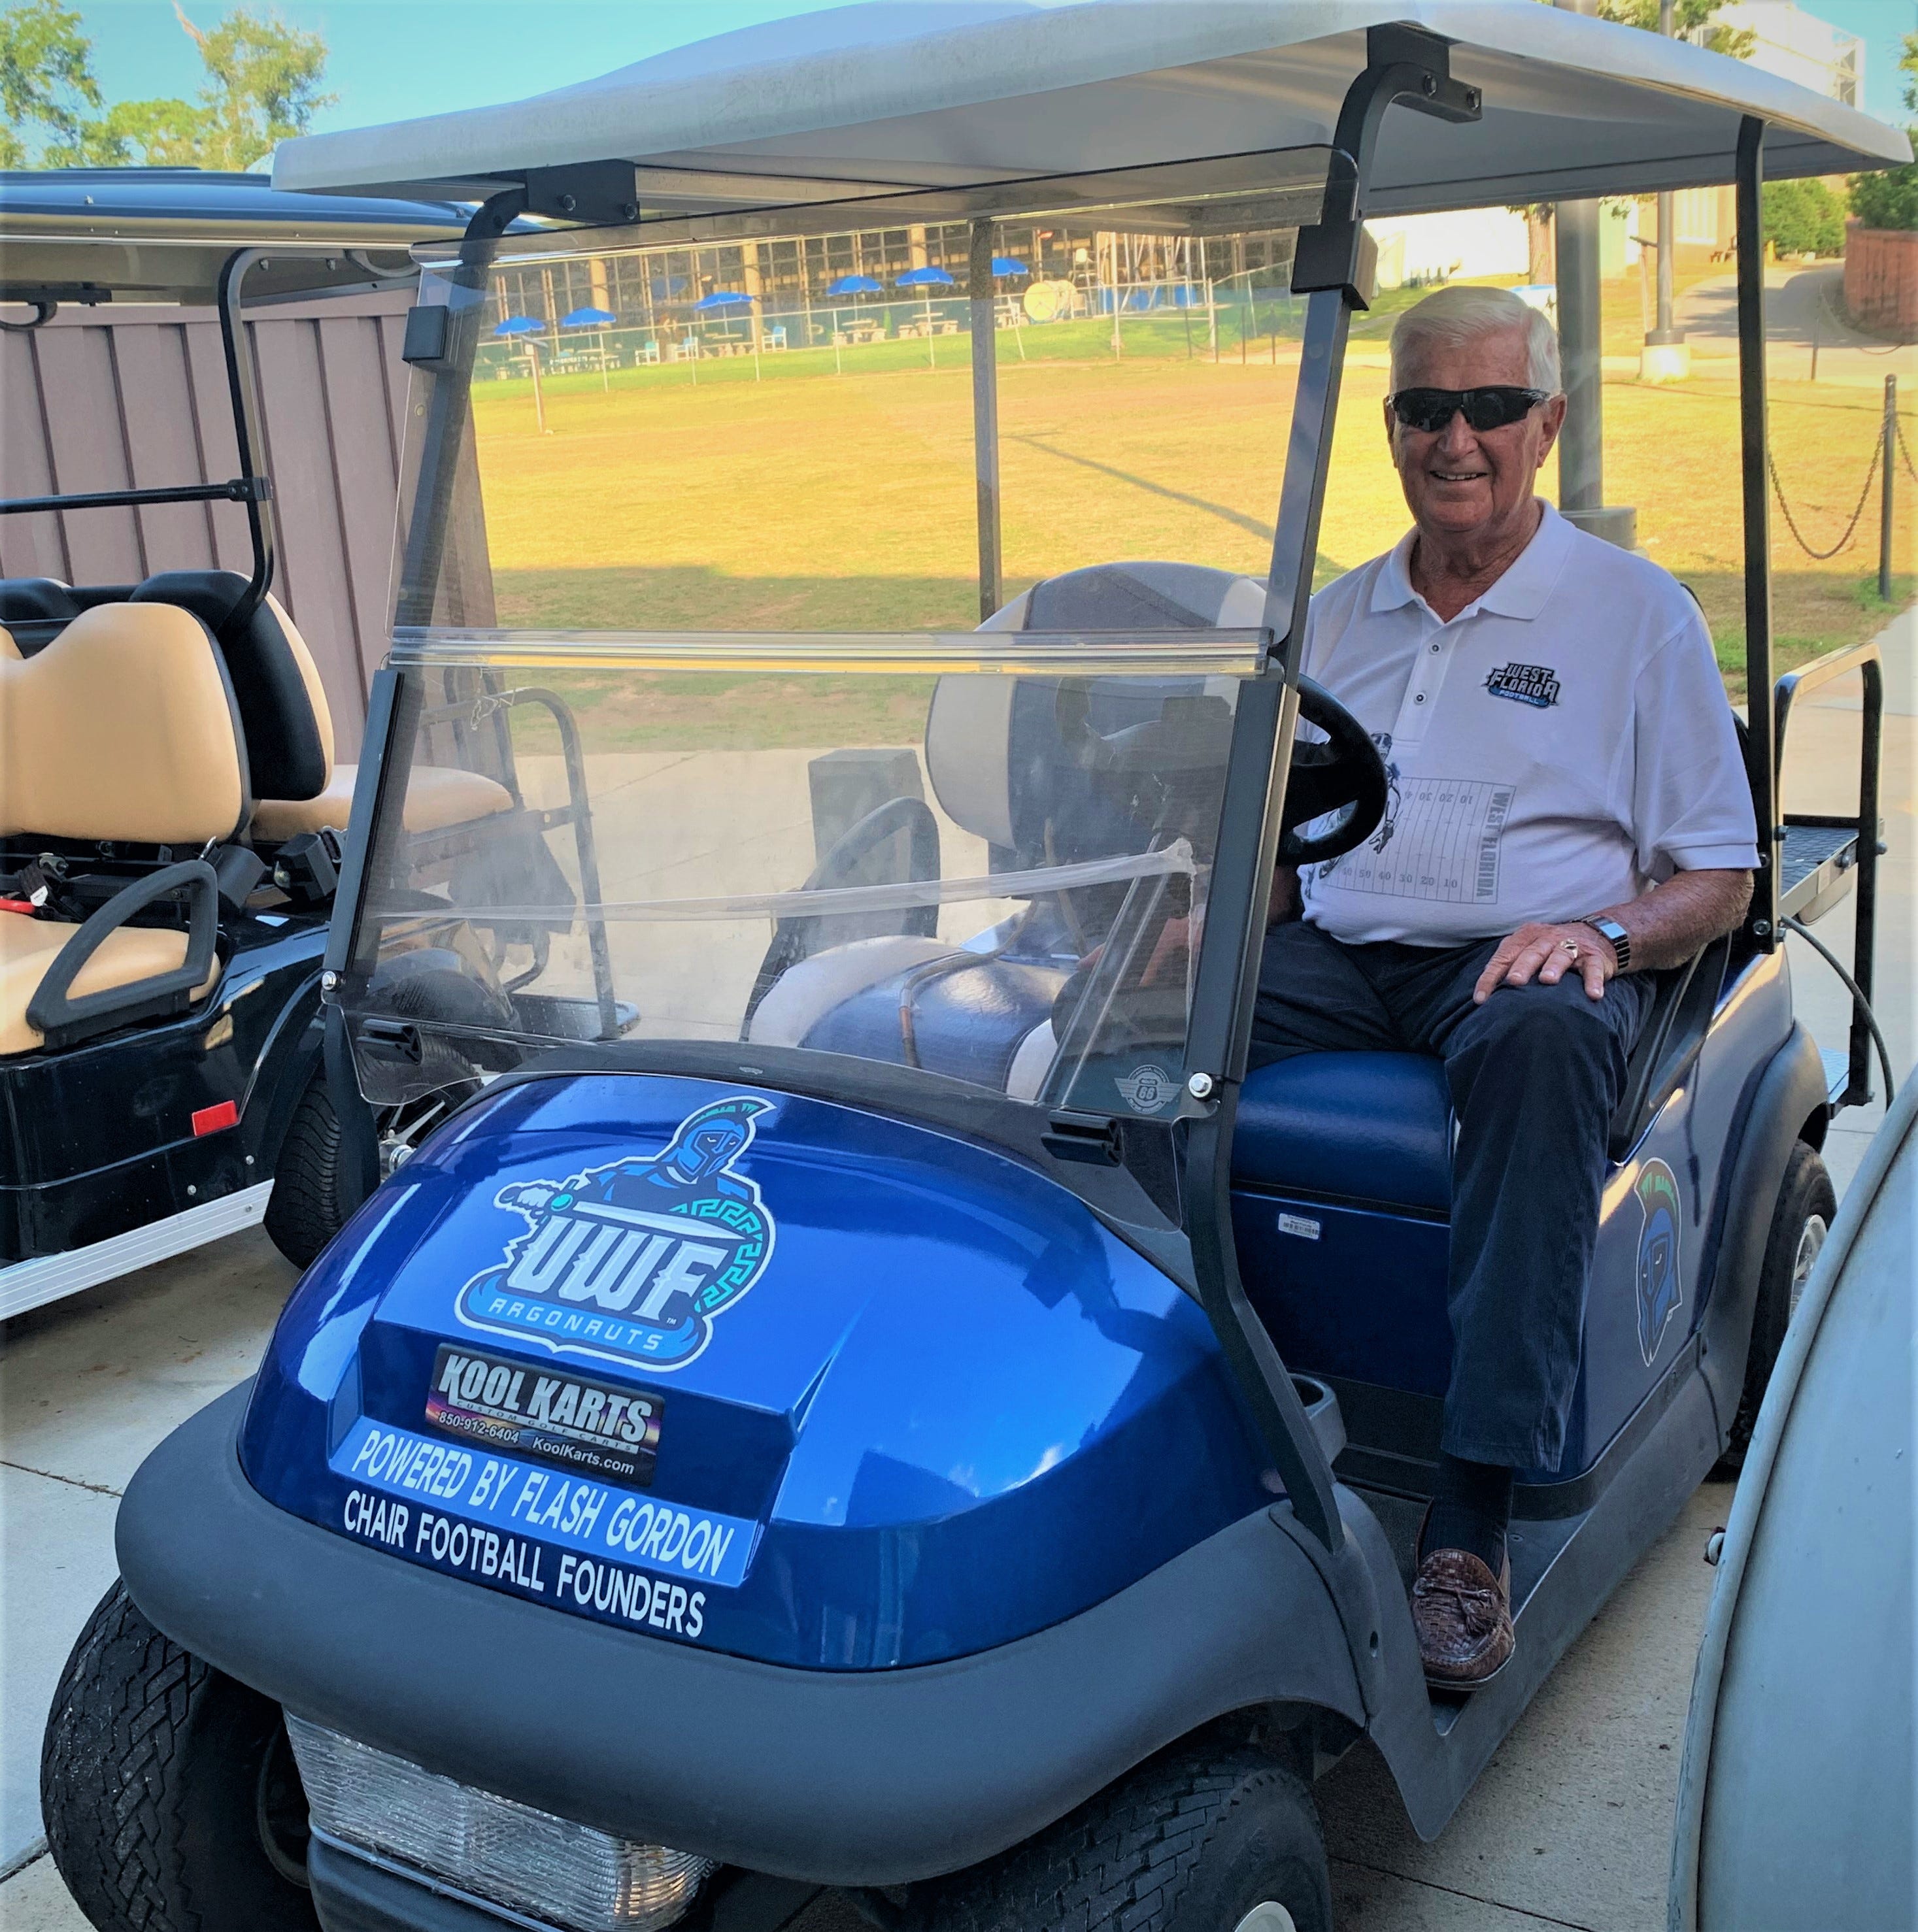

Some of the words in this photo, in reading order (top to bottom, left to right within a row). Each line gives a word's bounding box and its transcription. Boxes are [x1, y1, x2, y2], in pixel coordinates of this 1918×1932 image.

[1489, 670, 1558, 703] FLORIDA
[1500, 690, 1539, 705] FOOTBALL
[1506, 664, 1553, 684] WEST
[1485, 792, 1511, 831] WEST
[1475, 837, 1498, 897] FLORIDA
[507, 1215, 729, 1320] UWF
[488, 1298, 663, 1350] ARGONAUTS
[438, 1354, 526, 1411] KOOL
[527, 1376, 652, 1442] KARTS
[458, 1401, 517, 1422] CUSTOM
[528, 1420, 569, 1434] GOLF
[579, 1433, 632, 1451] CARTS
[439, 1411, 520, 1443] 850-912-6404
[533, 1437, 635, 1474] KoolKarts.com
[352, 1429, 472, 1499] POWERED
[468, 1460, 518, 1510] BY
[511, 1471, 608, 1539] FLASH
[606, 1497, 734, 1577] GORDON
[344, 1490, 409, 1548] CHAIR
[415, 1514, 545, 1591] FOOTBALL
[556, 1555, 706, 1637] FOUNDERS
